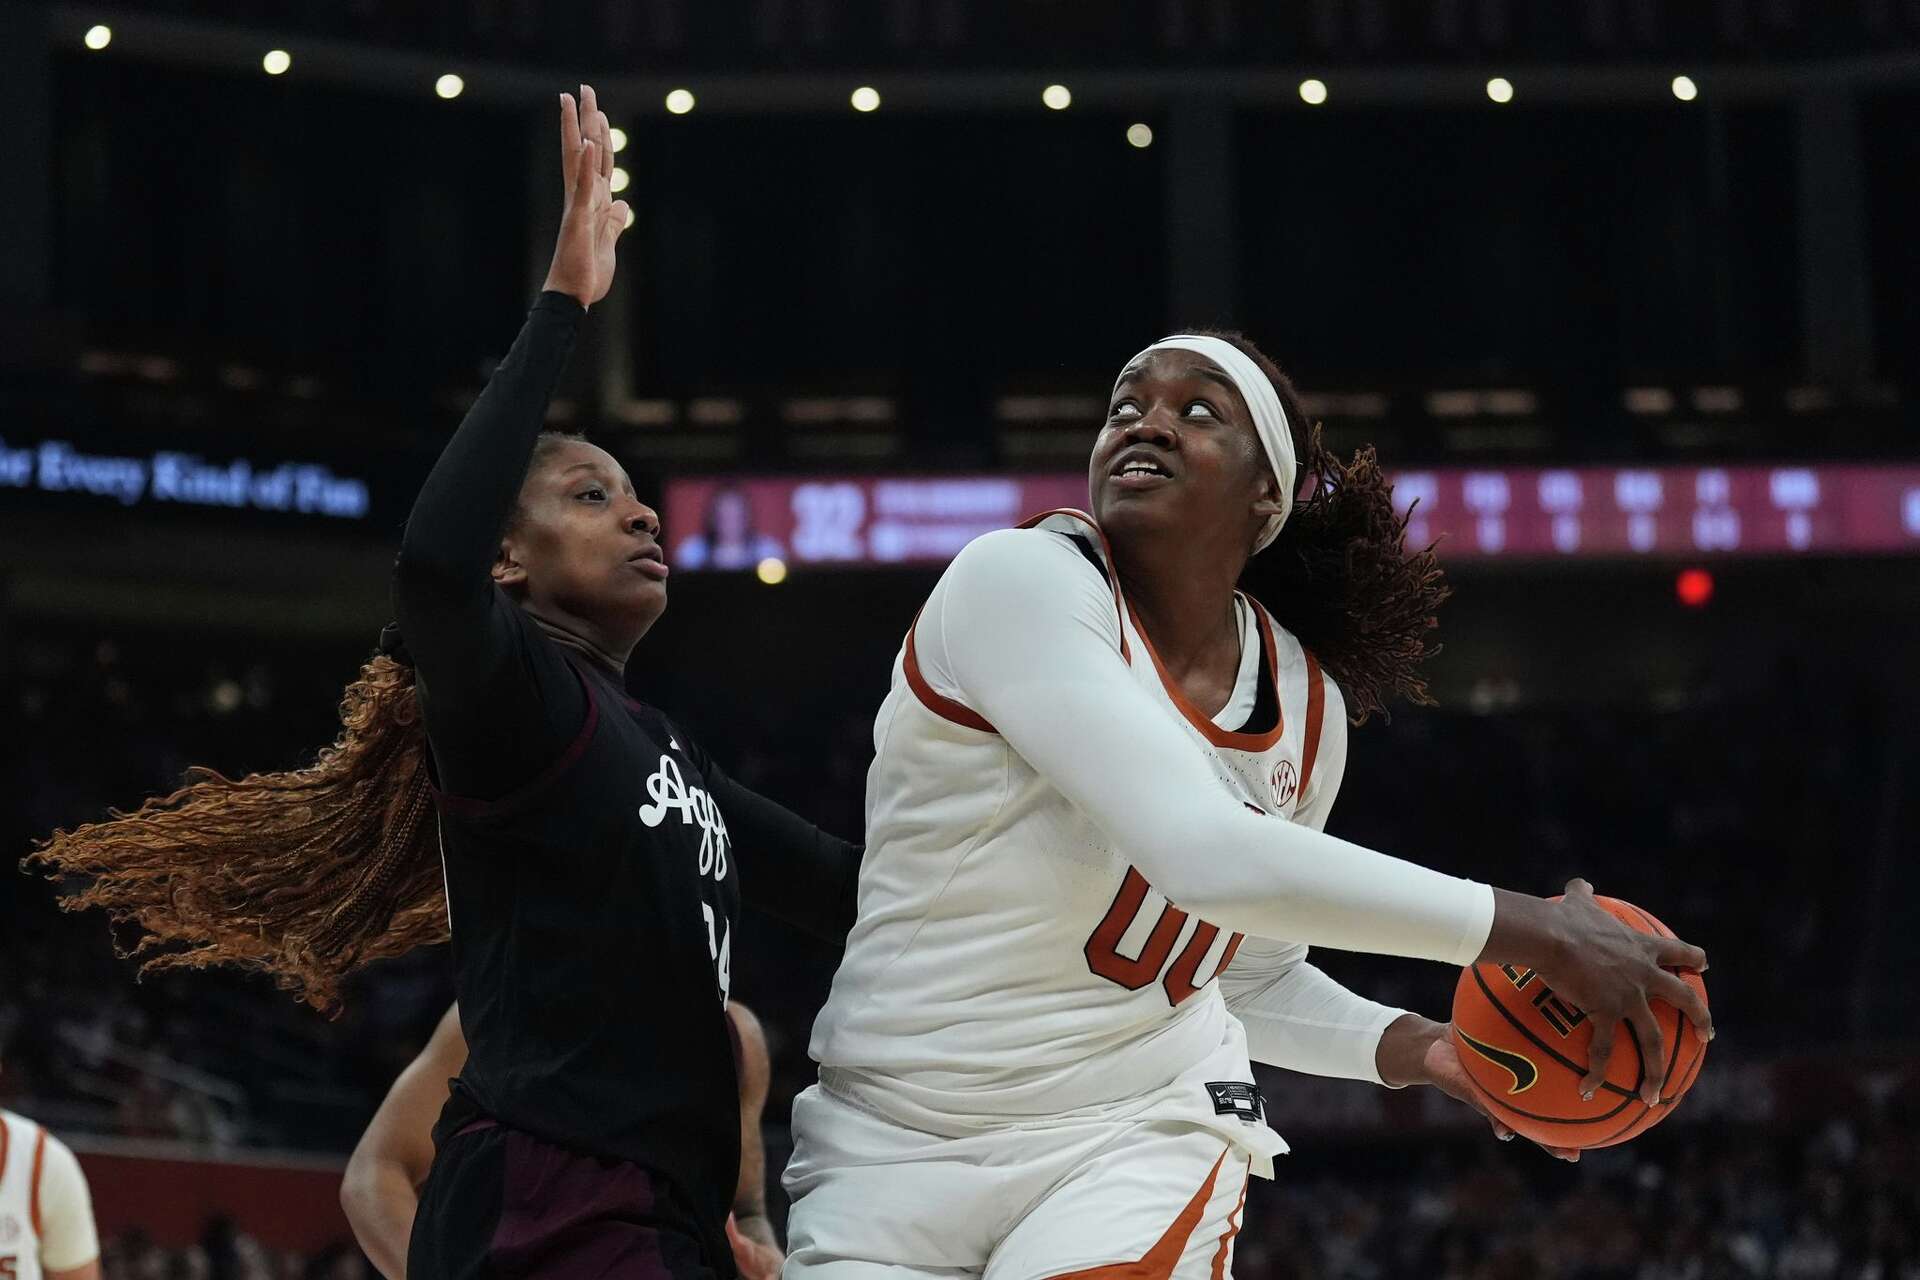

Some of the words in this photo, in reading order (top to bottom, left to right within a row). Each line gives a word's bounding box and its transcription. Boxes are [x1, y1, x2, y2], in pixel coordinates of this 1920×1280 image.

[38, 439, 144, 504] Every
[152, 451, 250, 506] Kind
[251, 463, 295, 510] of
[295, 463, 370, 518] Fun
